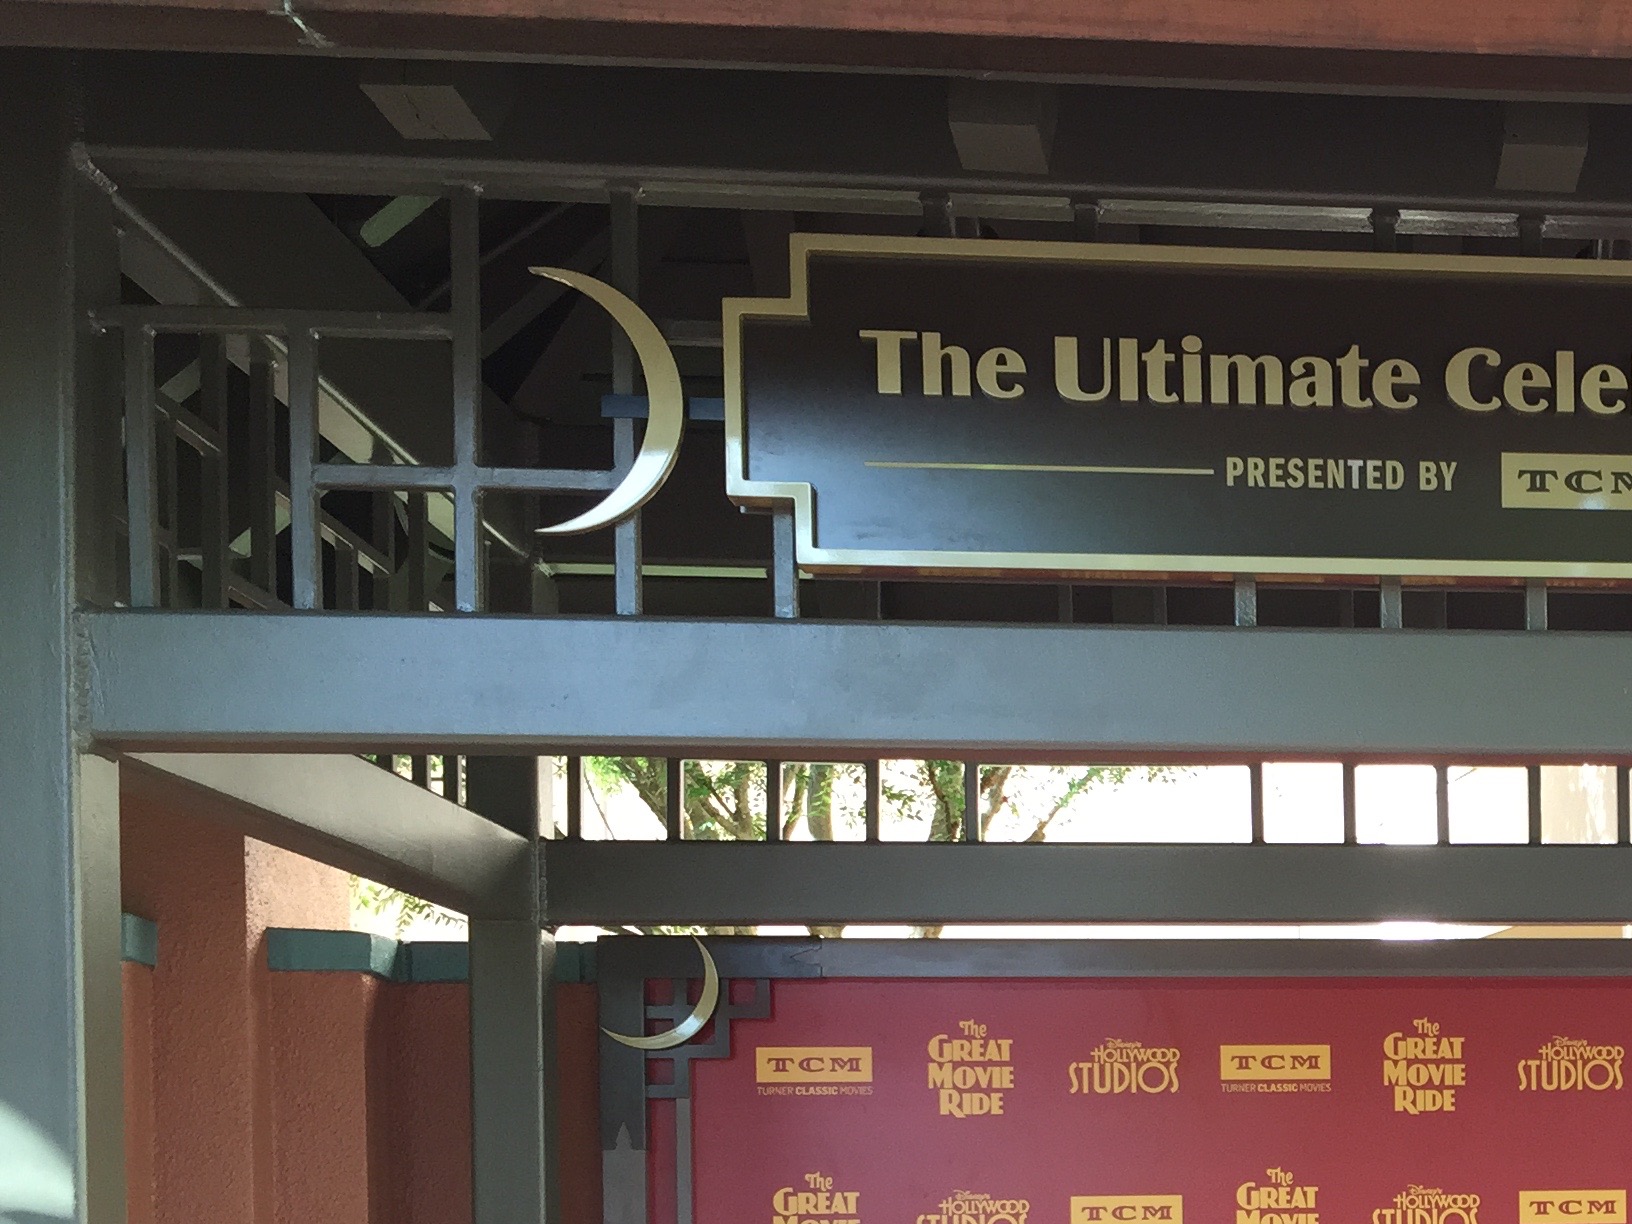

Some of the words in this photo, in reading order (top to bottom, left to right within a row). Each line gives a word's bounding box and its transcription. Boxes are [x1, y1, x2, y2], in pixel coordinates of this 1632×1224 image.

[858, 328, 1028, 398] The
[1053, 335, 1421, 410] Ultimate
[1225, 456, 1406, 492] PRESENTED
[1418, 460, 1458, 492] BY
[959, 1019, 987, 1038] The
[928, 1036, 1012, 1064] GREAT
[1090, 1045, 1180, 1064] HOLLYWOOD
[1384, 1033, 1465, 1061] GREAT
[768, 1058, 860, 1072] TCM
[928, 1063, 1013, 1090] MOVIE
[1069, 1061, 1179, 1093] STUDIOS
[1231, 1056, 1320, 1071] TCM
[1384, 1060, 1466, 1087] MOVIE
[1518, 1059, 1623, 1091] STUDIOS
[757, 1084, 793, 1094] TURNER
[794, 1084, 836, 1093] CLASSIC
[837, 1083, 872, 1092] MOVIES
[1395, 1085, 1458, 1114] RIDE
[939, 1088, 1004, 1117] RIDE
[773, 1189, 858, 1218] GREAT
[1236, 1183, 1318, 1212] GREAT
[1393, 1191, 1480, 1210] HOLLYWOOD
[1530, 1200, 1616, 1215] TCM
[1081, 1205, 1172, 1221] TCM
